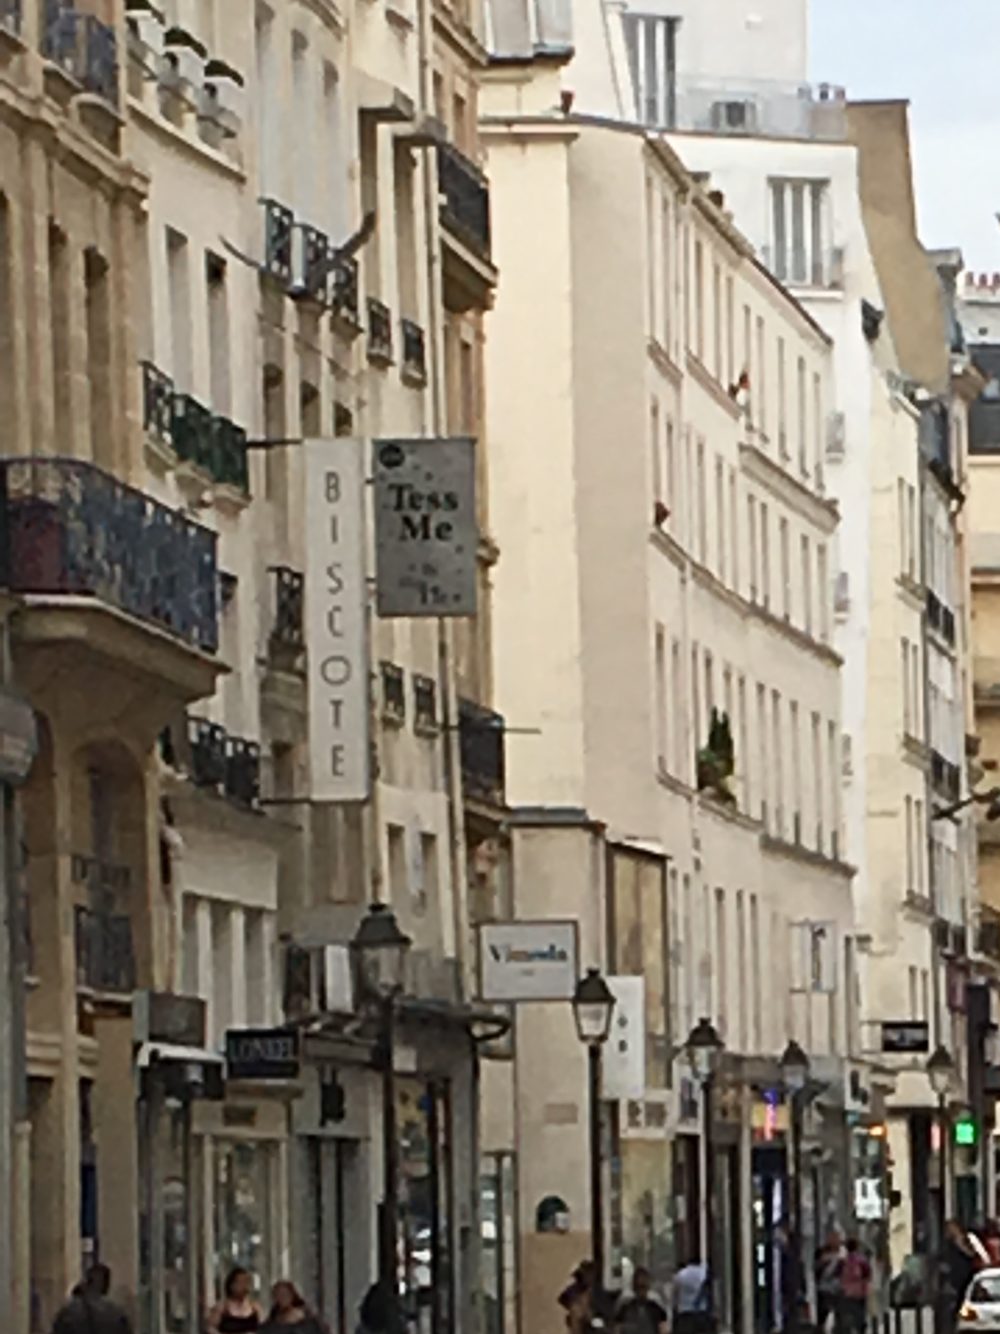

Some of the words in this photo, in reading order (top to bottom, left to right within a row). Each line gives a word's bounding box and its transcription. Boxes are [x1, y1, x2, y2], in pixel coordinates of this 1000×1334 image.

[387, 483, 459, 512] Tess
[400, 515, 454, 541] Me
[320, 471, 351, 777] BISCOTE
